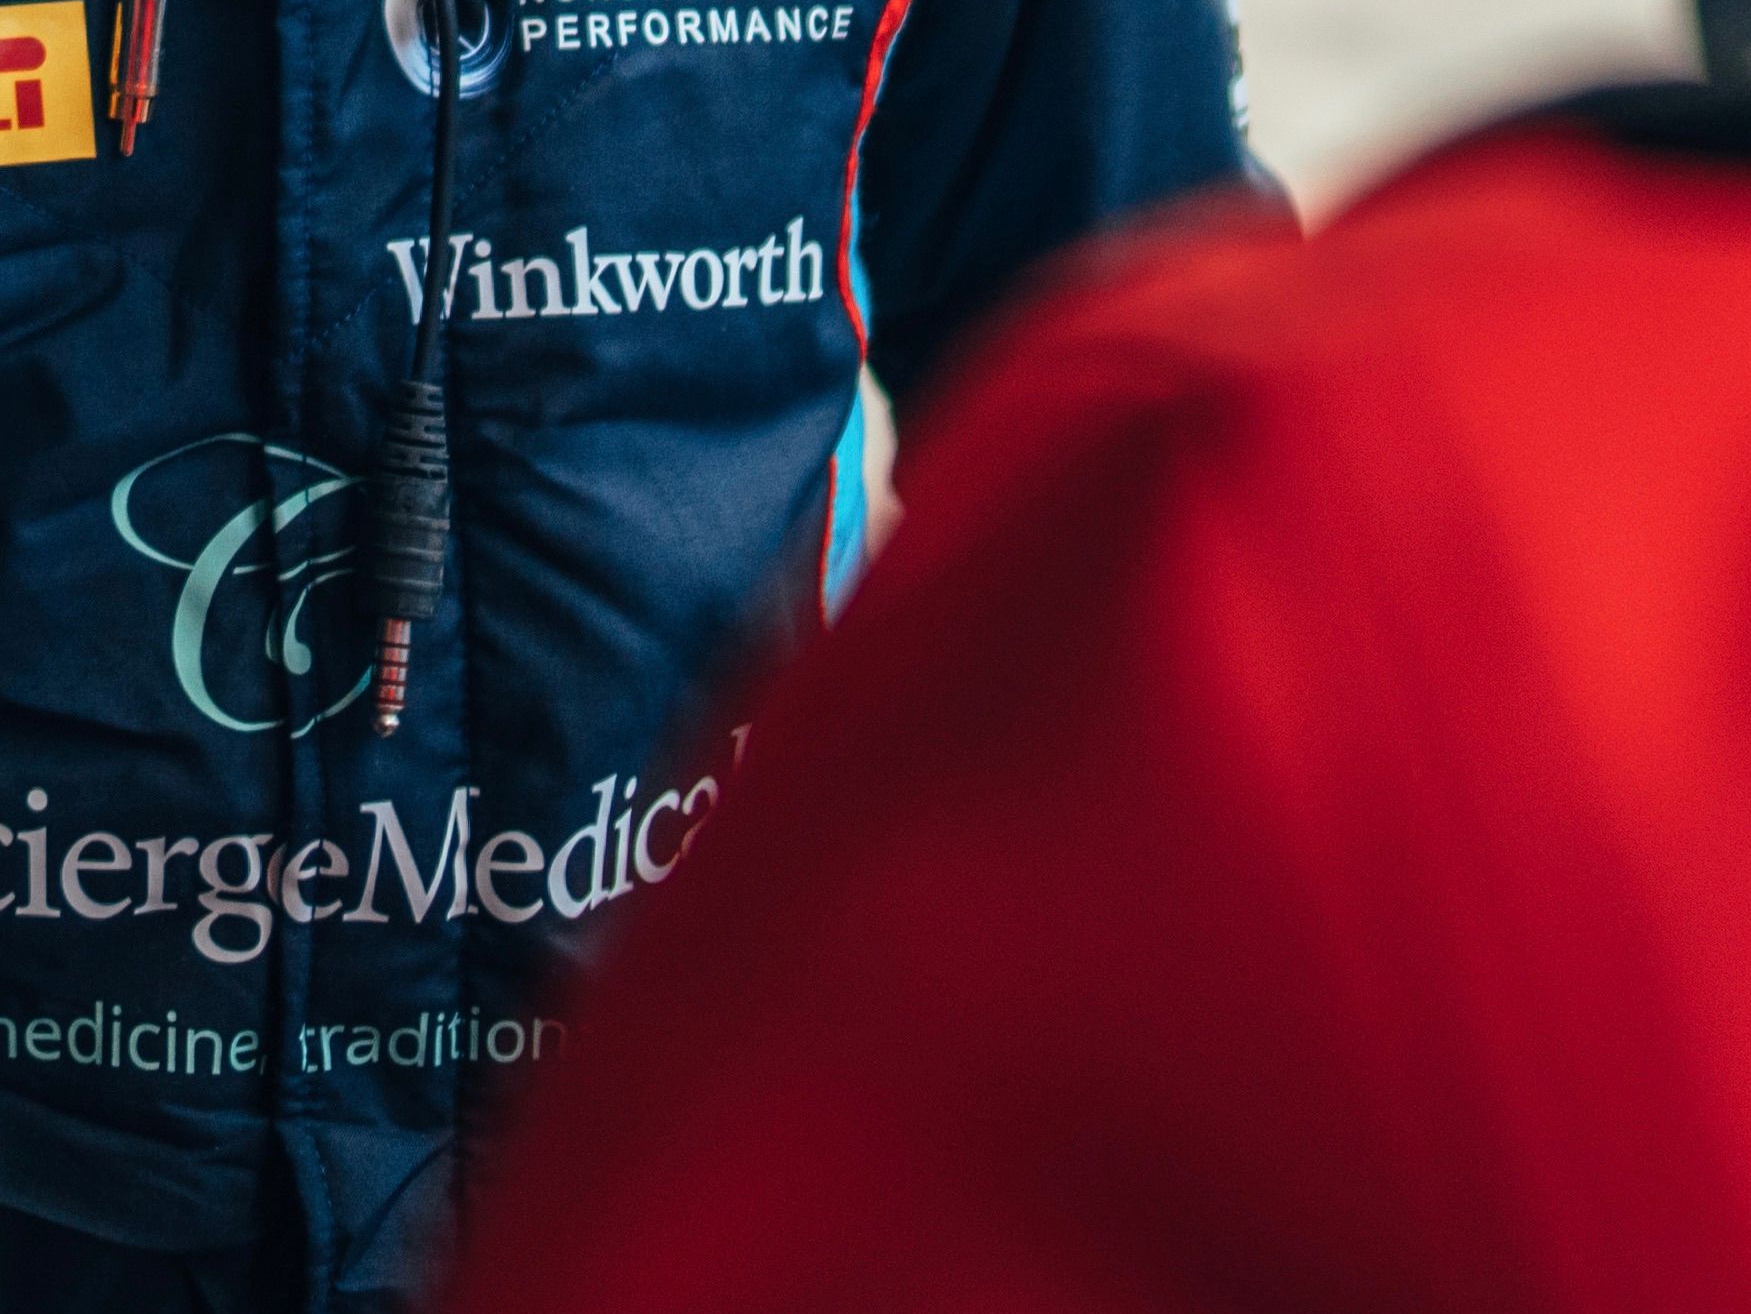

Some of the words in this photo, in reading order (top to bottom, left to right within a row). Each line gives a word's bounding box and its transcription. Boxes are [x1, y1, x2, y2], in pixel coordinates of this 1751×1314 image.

[520, 5, 855, 53] PERFORMANCE
[386, 216, 824, 326] Winkworth
[298, 1005, 570, 1074] tradition
